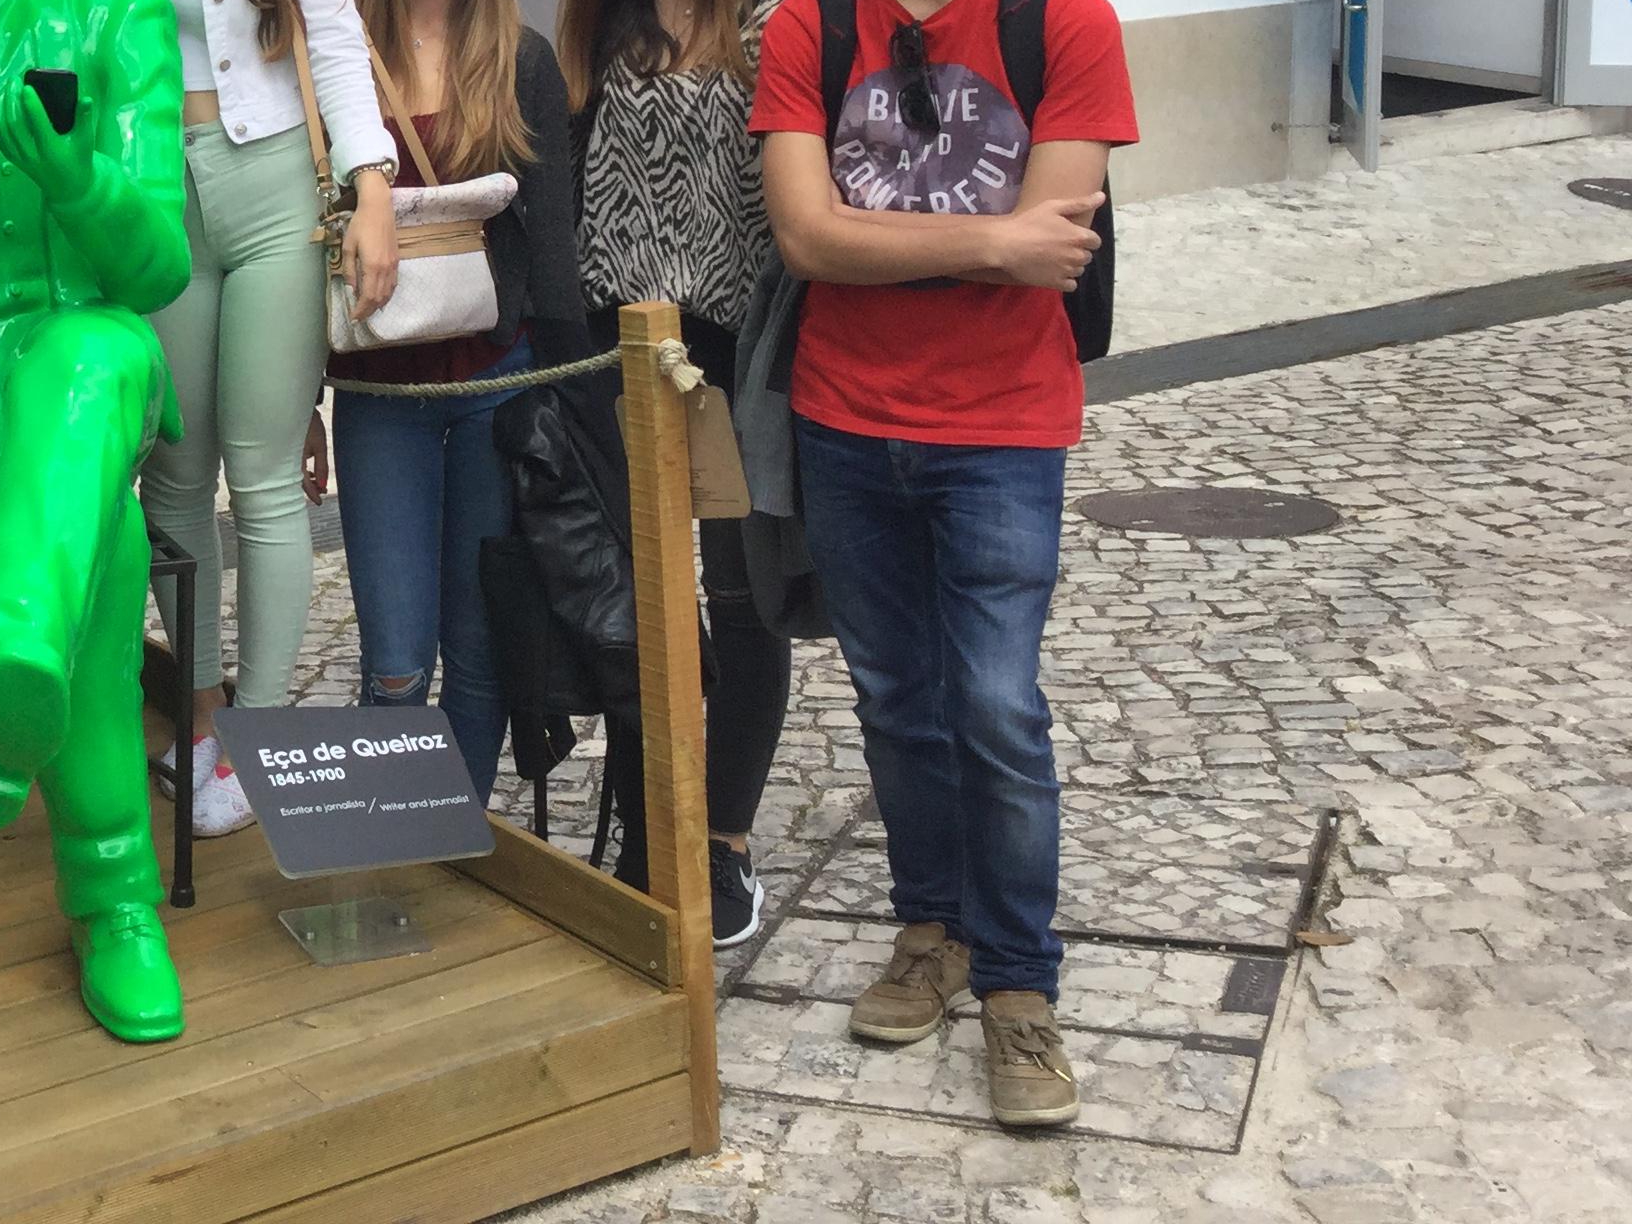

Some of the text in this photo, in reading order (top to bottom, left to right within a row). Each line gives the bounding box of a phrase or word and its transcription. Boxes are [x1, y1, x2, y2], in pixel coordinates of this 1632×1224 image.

[258, 733, 448, 769] Eça de Queiroz
[268, 767, 346, 787] 1845-1900
[408, 798, 429, 809] and
